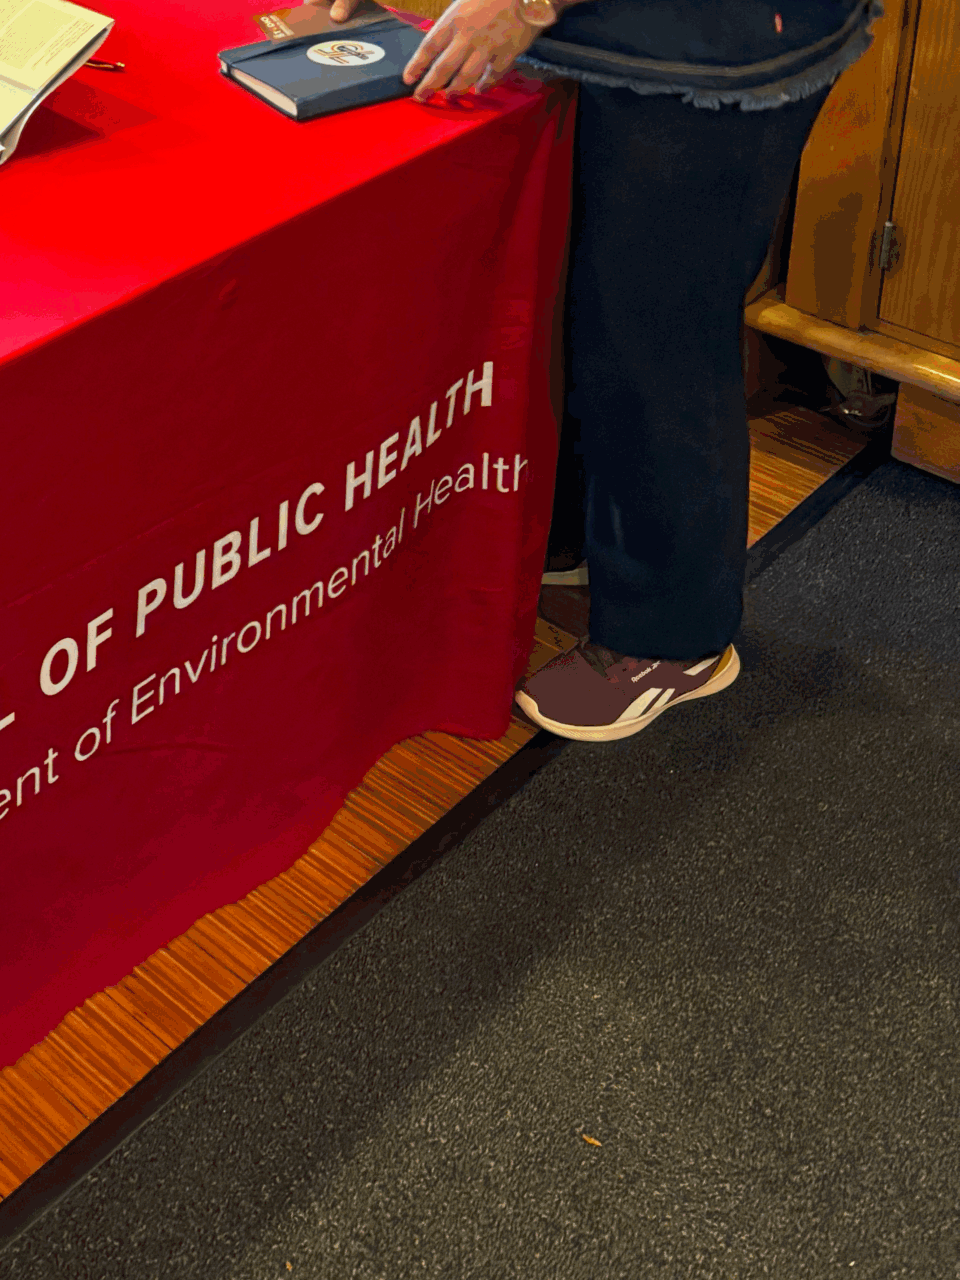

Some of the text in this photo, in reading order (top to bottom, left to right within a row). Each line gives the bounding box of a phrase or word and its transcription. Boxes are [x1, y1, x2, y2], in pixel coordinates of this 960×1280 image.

[40, 608, 113, 695] OF
[136, 483, 324, 637] PUBLIC
[345, 362, 493, 511] HEALTH
[75, 699, 119, 761] of
[132, 507, 405, 724] Environmental
